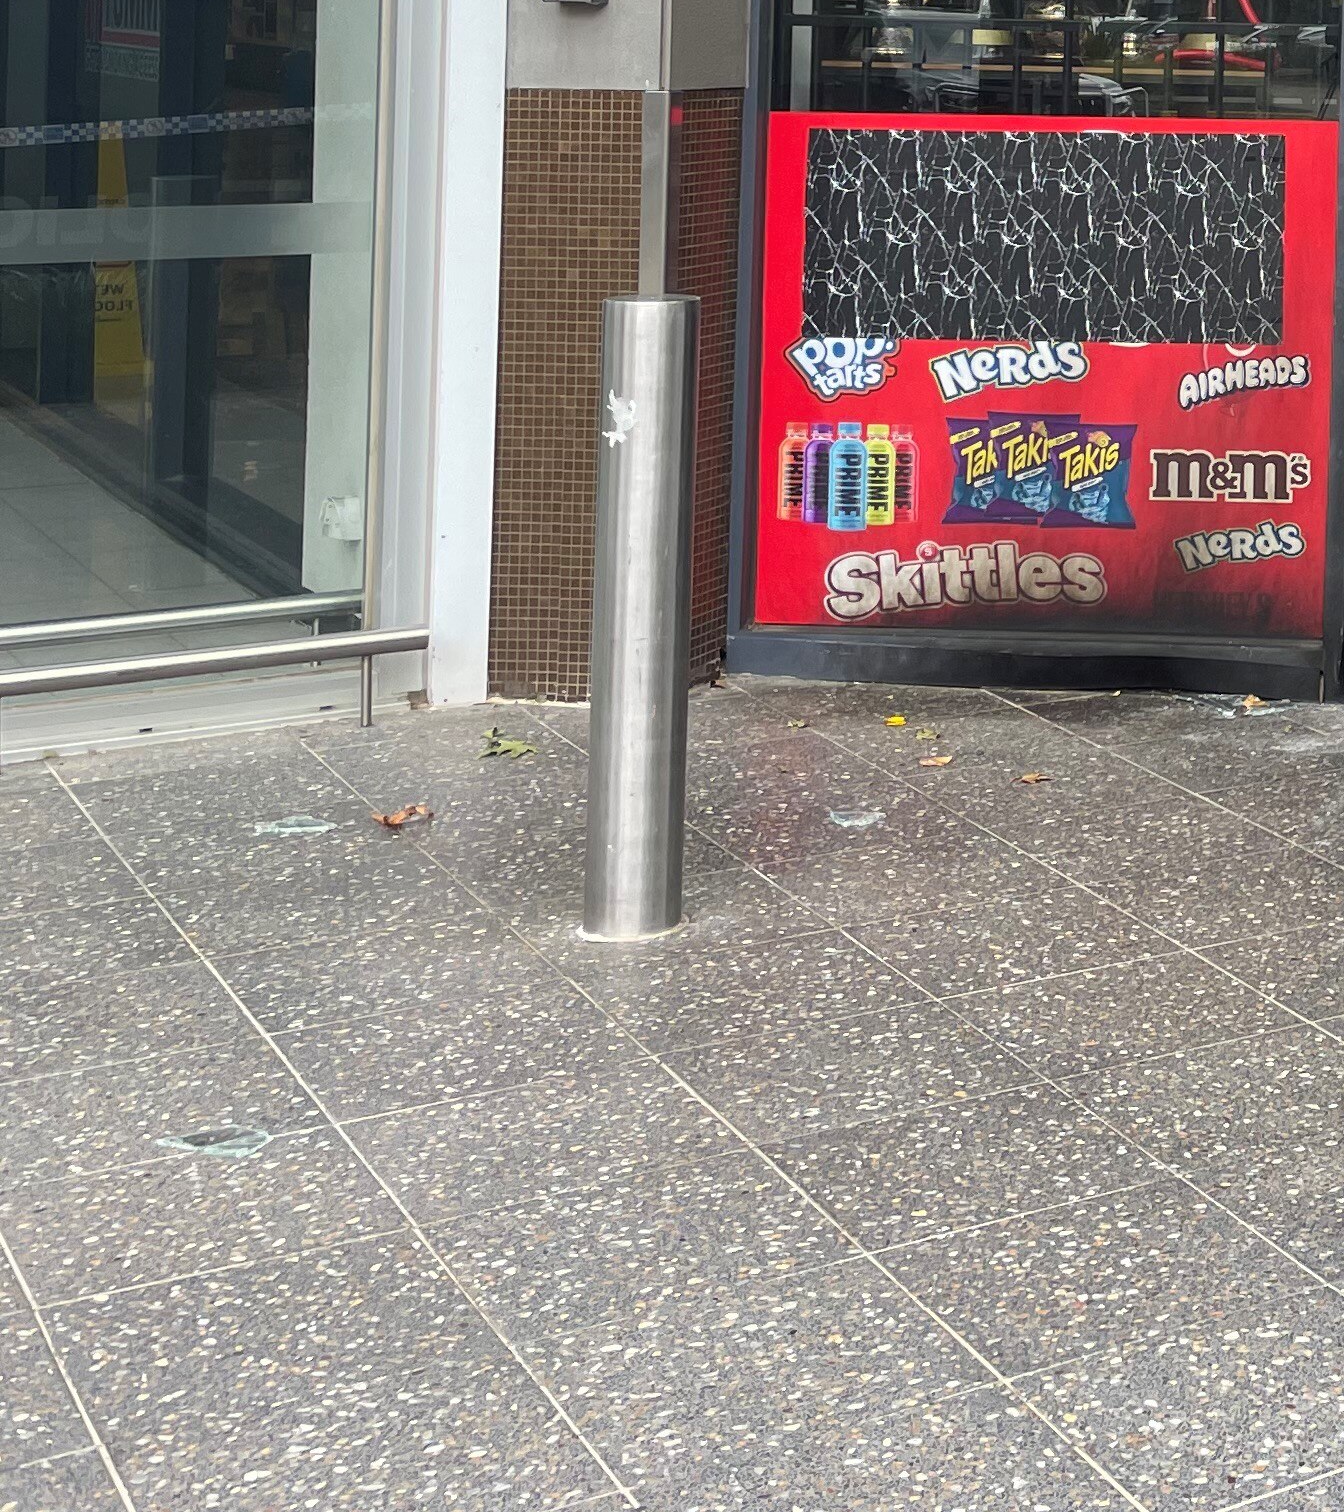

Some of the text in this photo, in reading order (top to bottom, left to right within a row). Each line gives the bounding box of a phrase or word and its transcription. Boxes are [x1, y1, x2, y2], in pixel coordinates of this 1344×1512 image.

[1179, 355, 1307, 407] AIRHEADS
[835, 453, 861, 517] PRIME
[867, 453, 889, 512] PRIME
[1002, 433, 1050, 479] Taki
[826, 542, 1103, 619] Skittles
